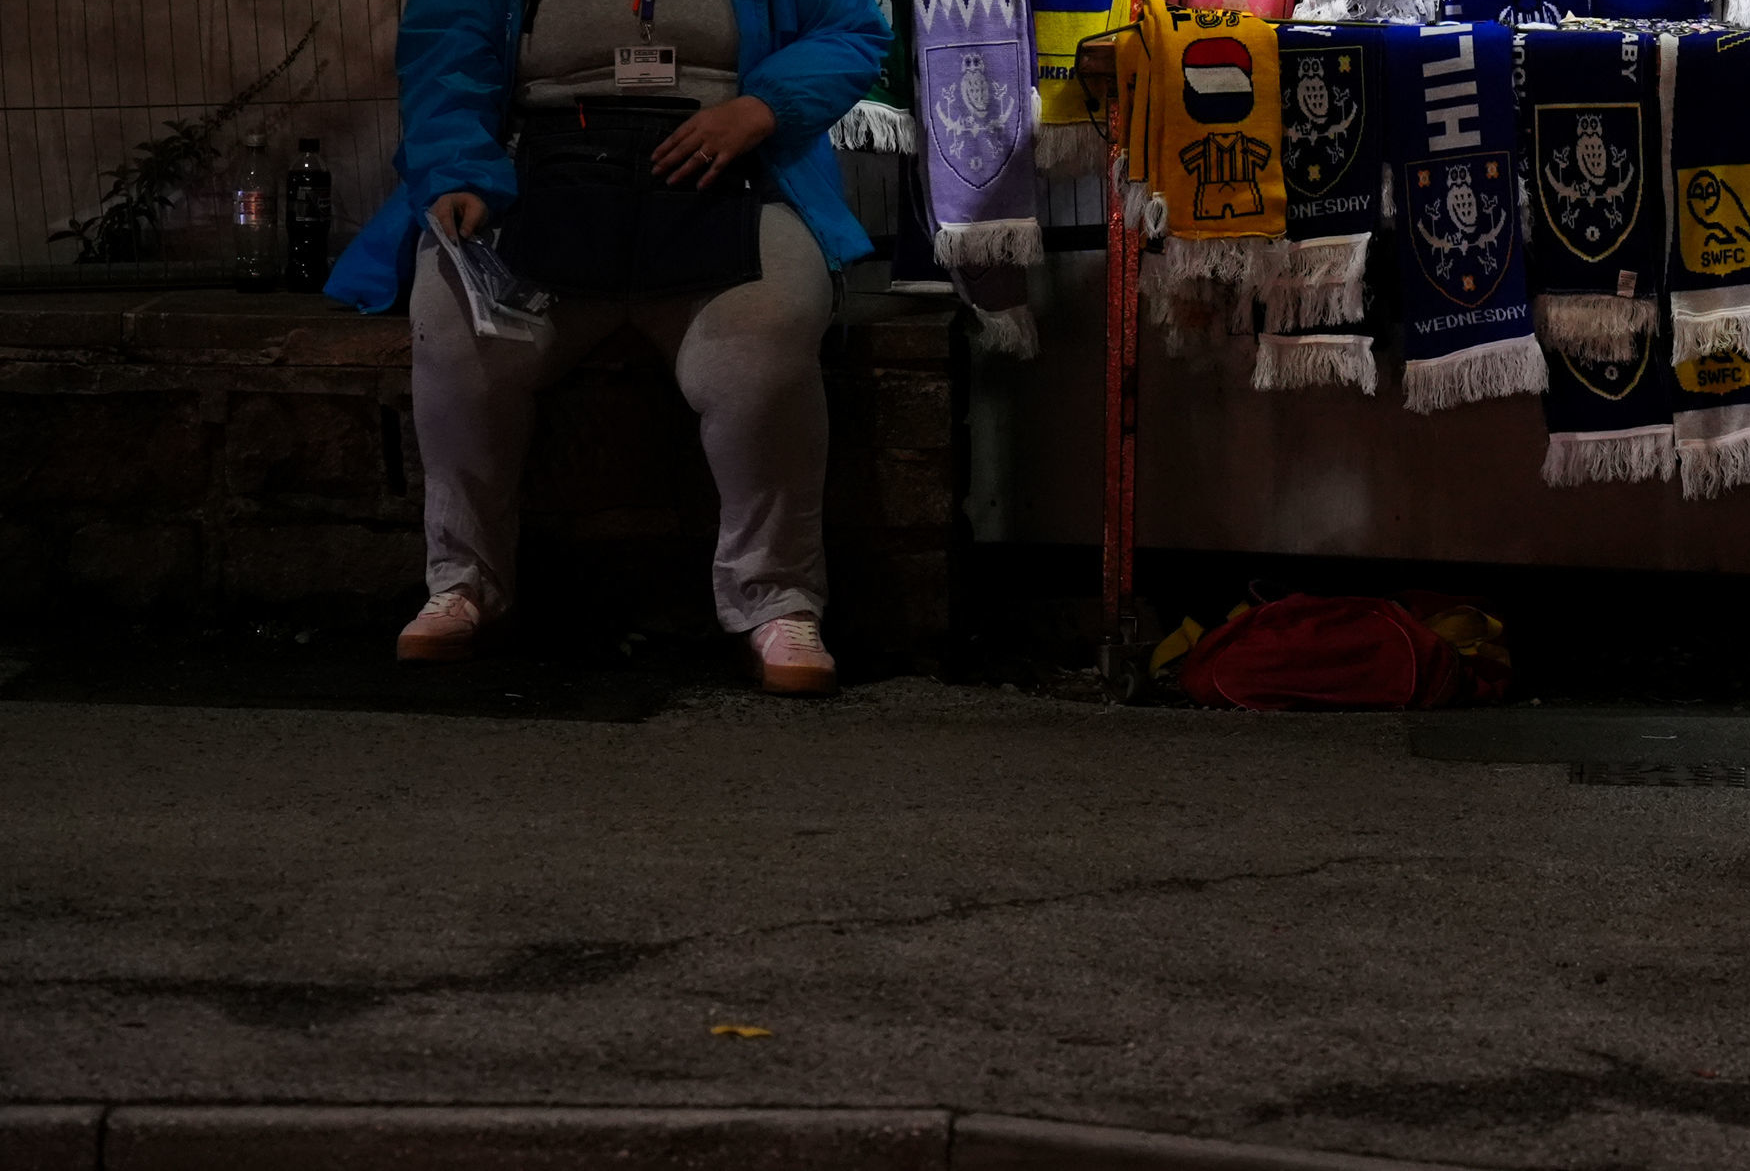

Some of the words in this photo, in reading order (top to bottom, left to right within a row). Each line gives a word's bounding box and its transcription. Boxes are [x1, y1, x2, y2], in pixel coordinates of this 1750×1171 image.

[1701, 248, 1746, 267] SWFC
[1414, 304, 1528, 336] WEDNESDAY
[1697, 367, 1743, 387] SWFC
